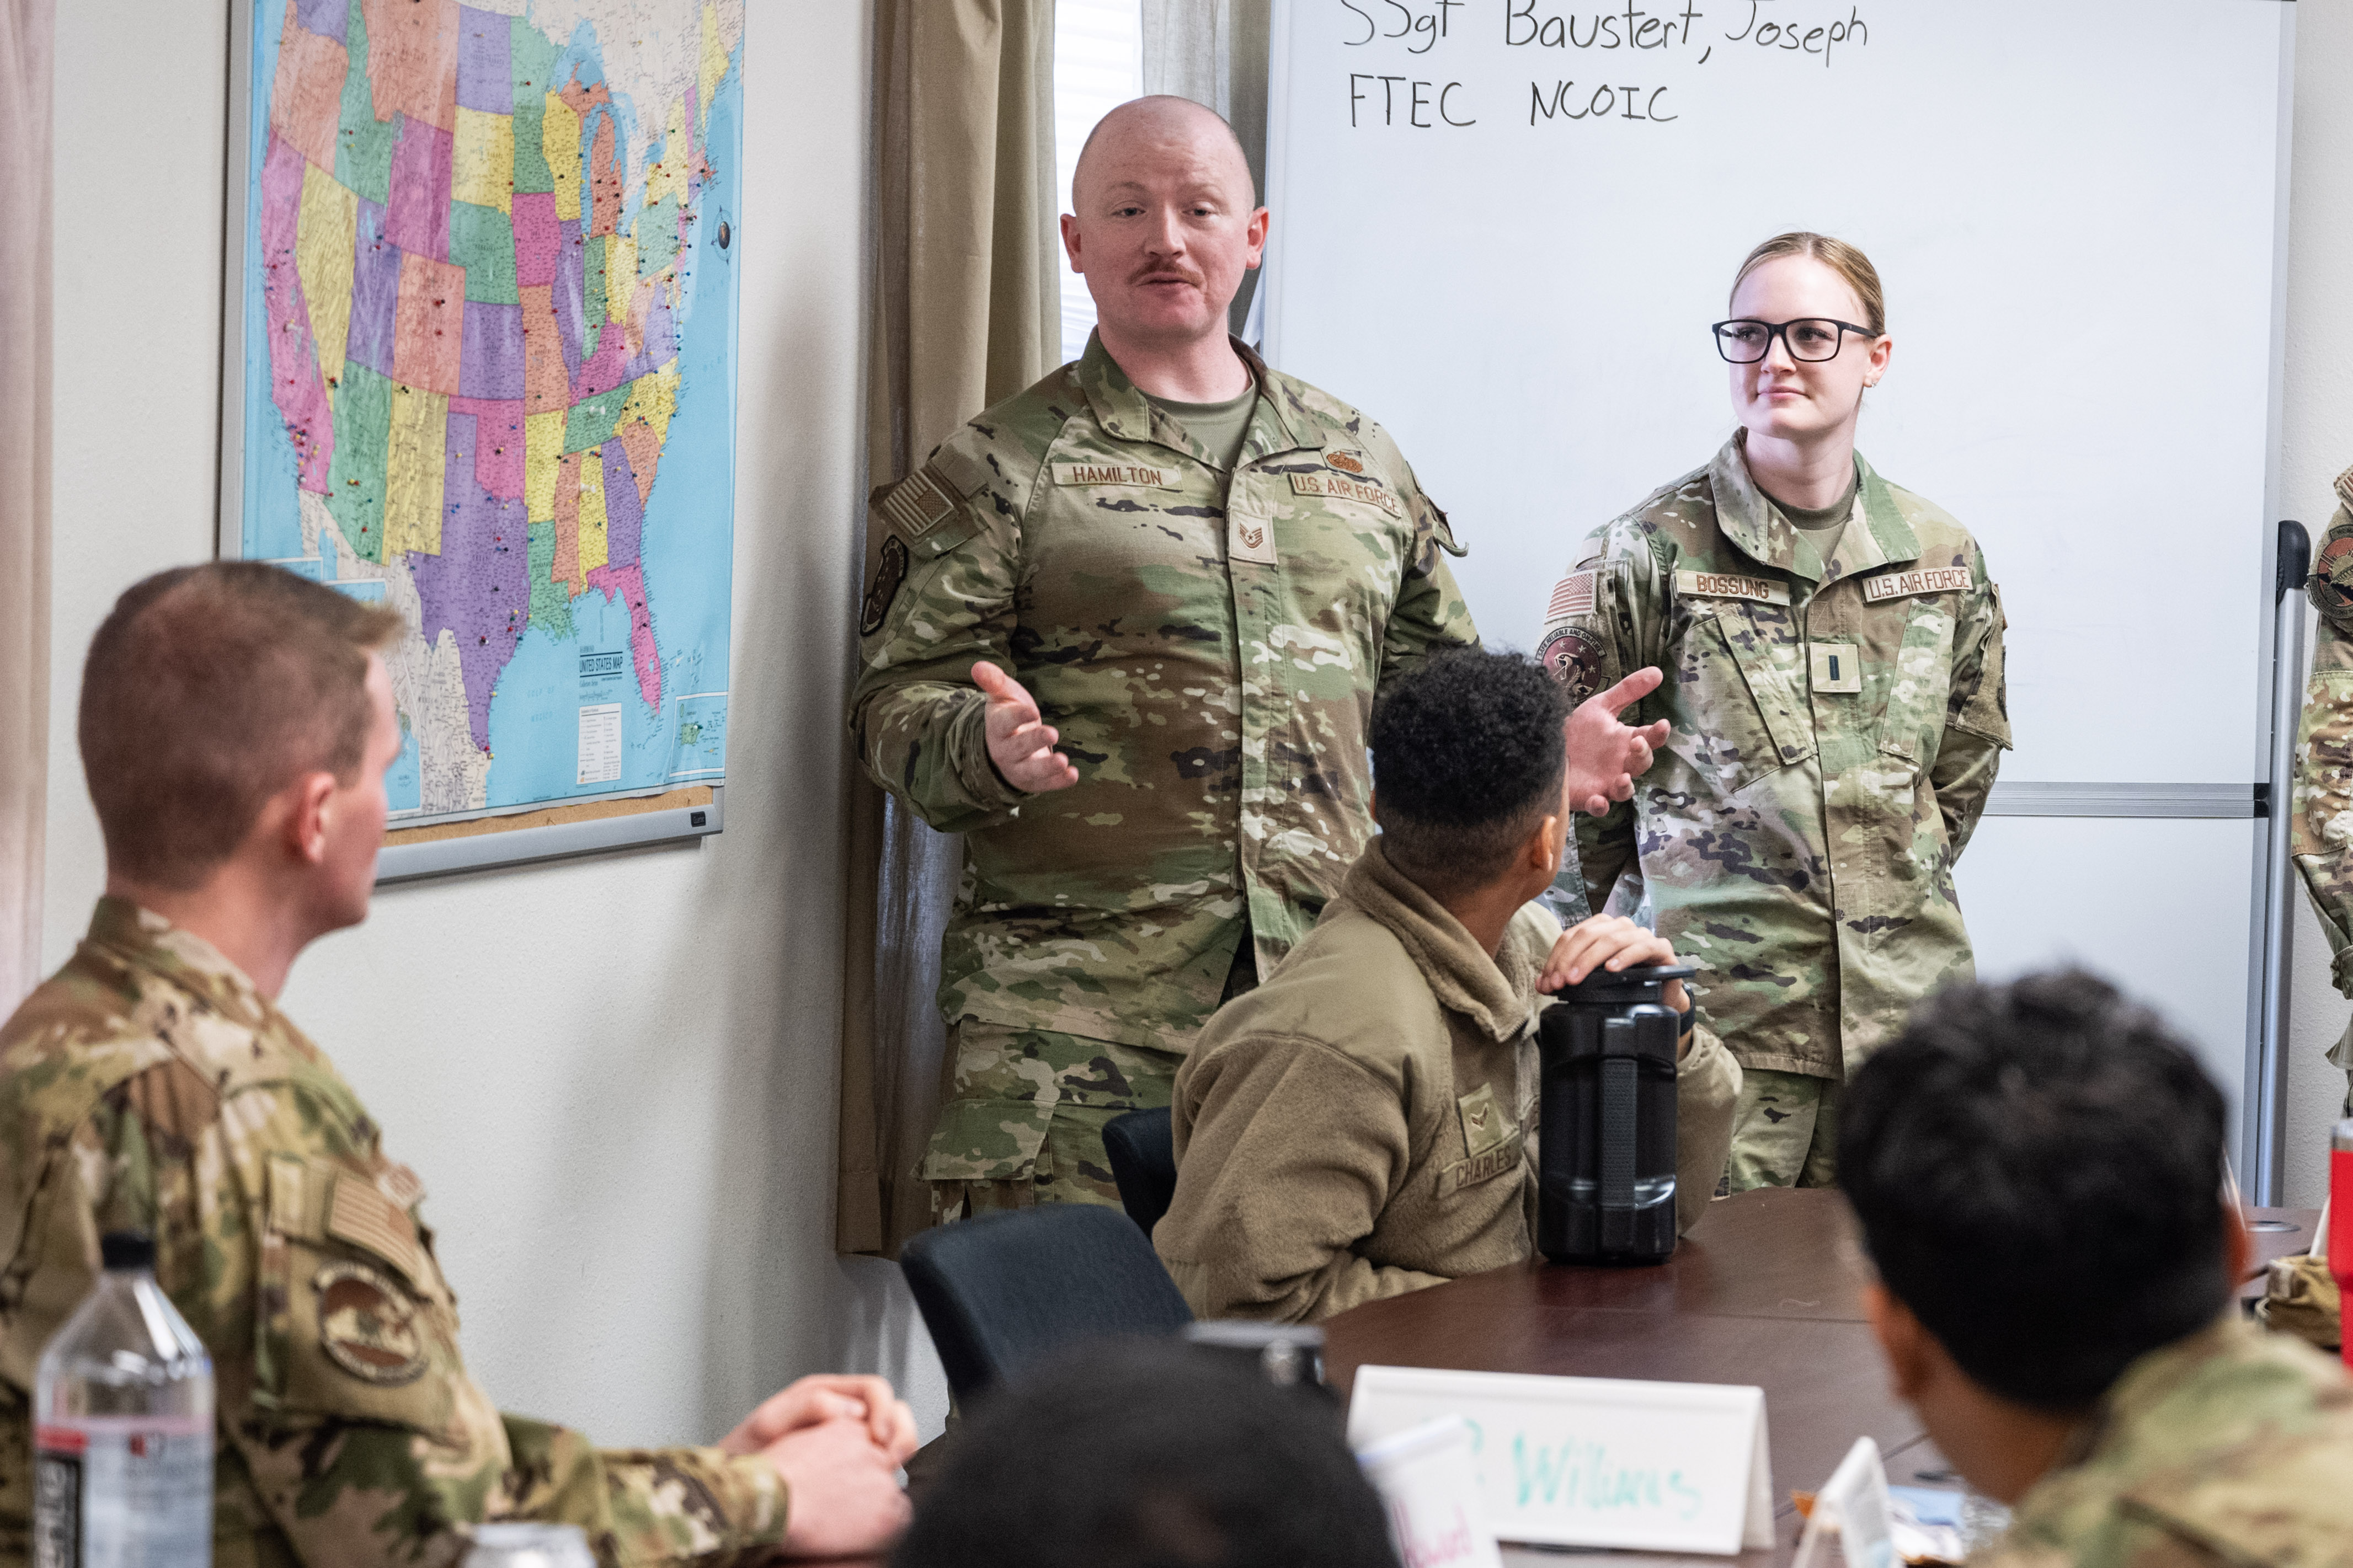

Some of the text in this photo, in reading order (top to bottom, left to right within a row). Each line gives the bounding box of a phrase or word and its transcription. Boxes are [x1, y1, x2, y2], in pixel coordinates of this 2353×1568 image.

[1725, 0, 1868, 68] Joseph
[1350, 73, 1678, 129] FTEC NCOIC
[1073, 466, 1162, 486] HAMILTON
[1294, 475, 1399, 514] U.S. AIR FORCE
[1696, 574, 1769, 599] BOSSUNG
[1868, 569, 1970, 599] U.S. AIR FORCE
[1538, 643, 1548, 657] SAFE
[1546, 629, 1568, 644] RELIABLE
[579, 656, 623, 673] UNITED STATES MAP
[1456, 1145, 1512, 1187] CHARLES
